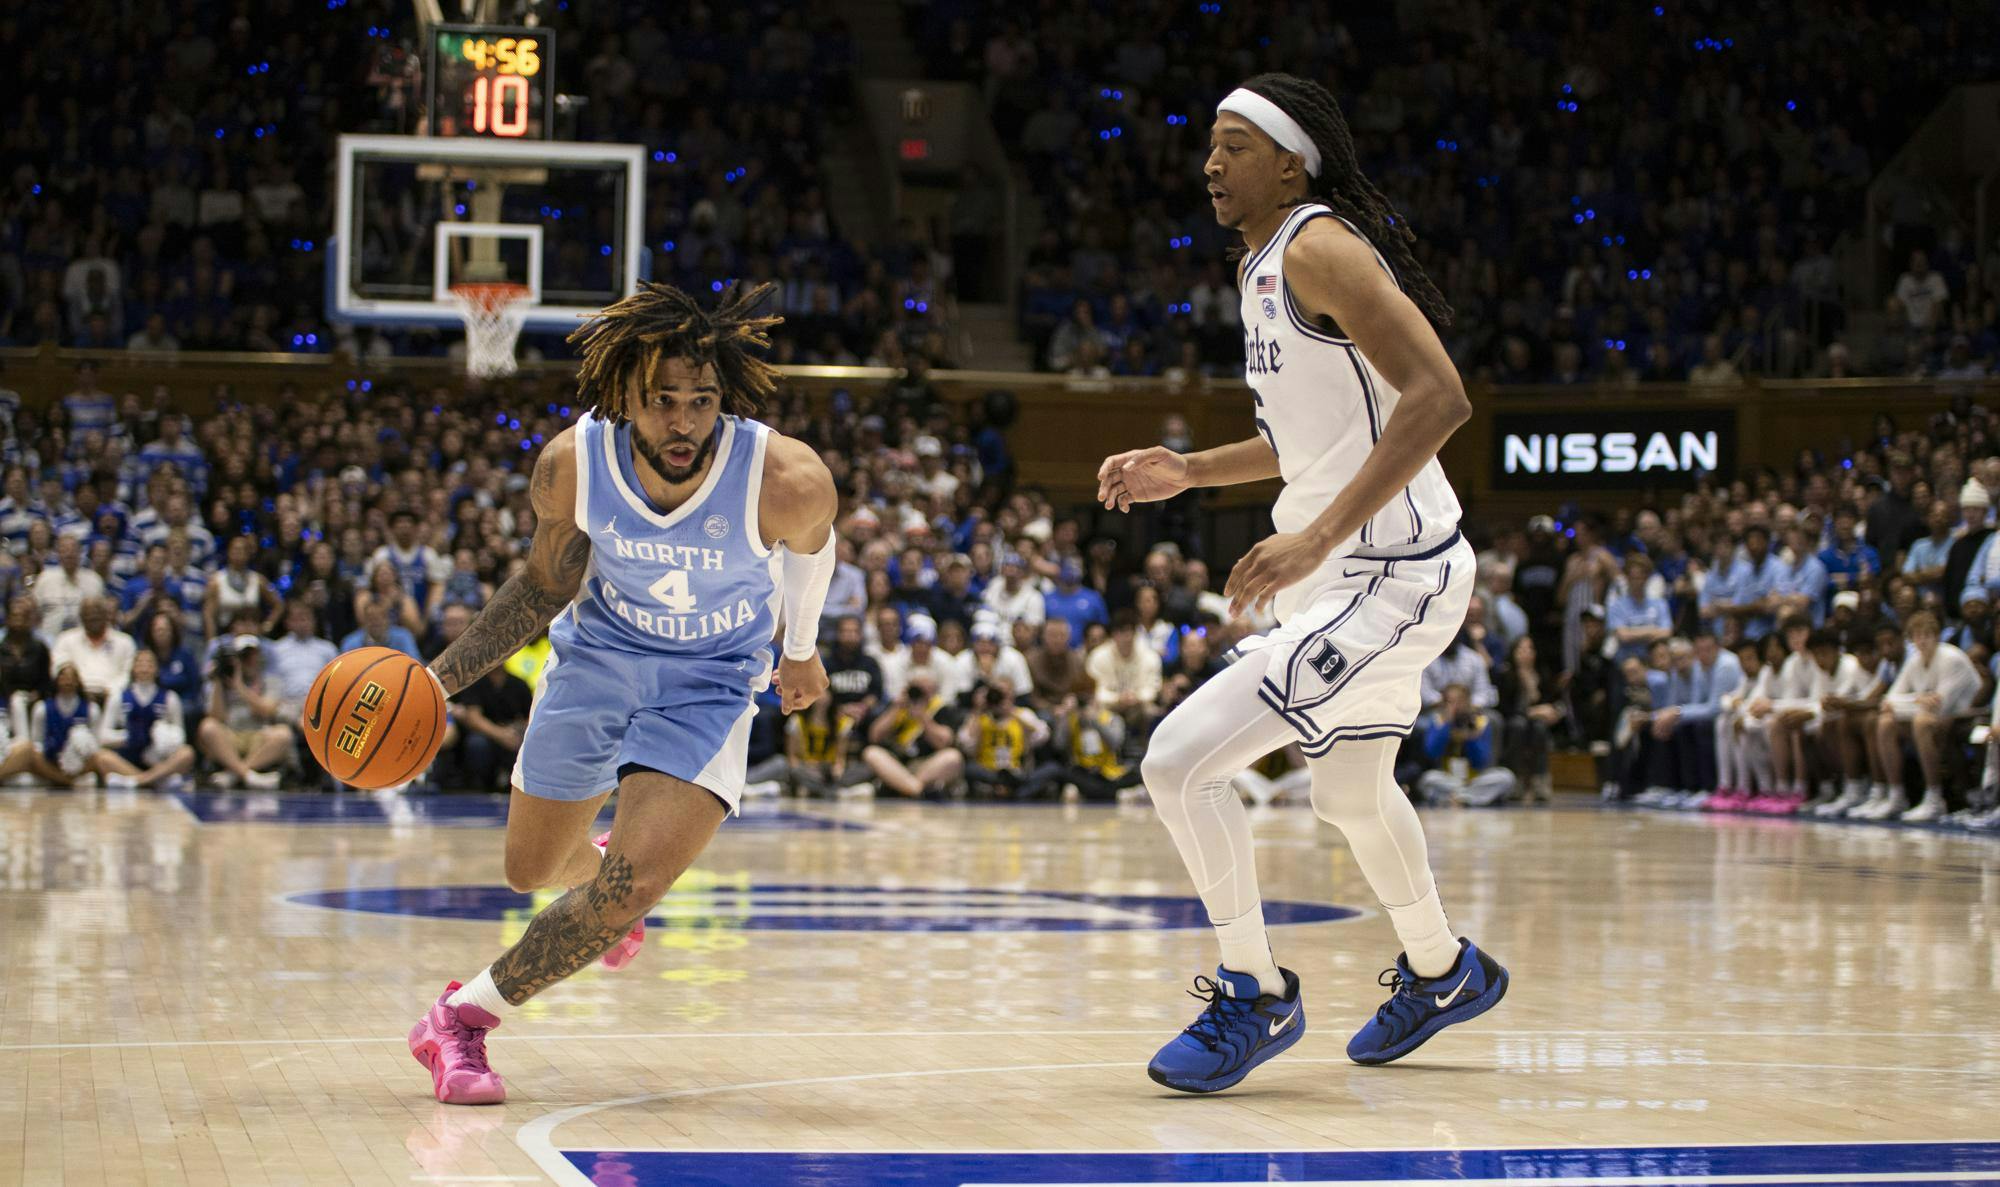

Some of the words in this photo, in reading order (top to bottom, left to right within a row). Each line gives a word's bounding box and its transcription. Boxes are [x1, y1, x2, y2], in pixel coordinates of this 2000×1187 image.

[462, 38, 540, 76] 4:56
[473, 75, 529, 137] 10
[1245, 323, 1284, 375] uke
[1504, 431, 1718, 474] NISSAN
[614, 538, 724, 571] NORTH
[602, 580, 757, 641] CAROLINA
[648, 570, 698, 614] 4
[335, 680, 388, 757] ELITE
